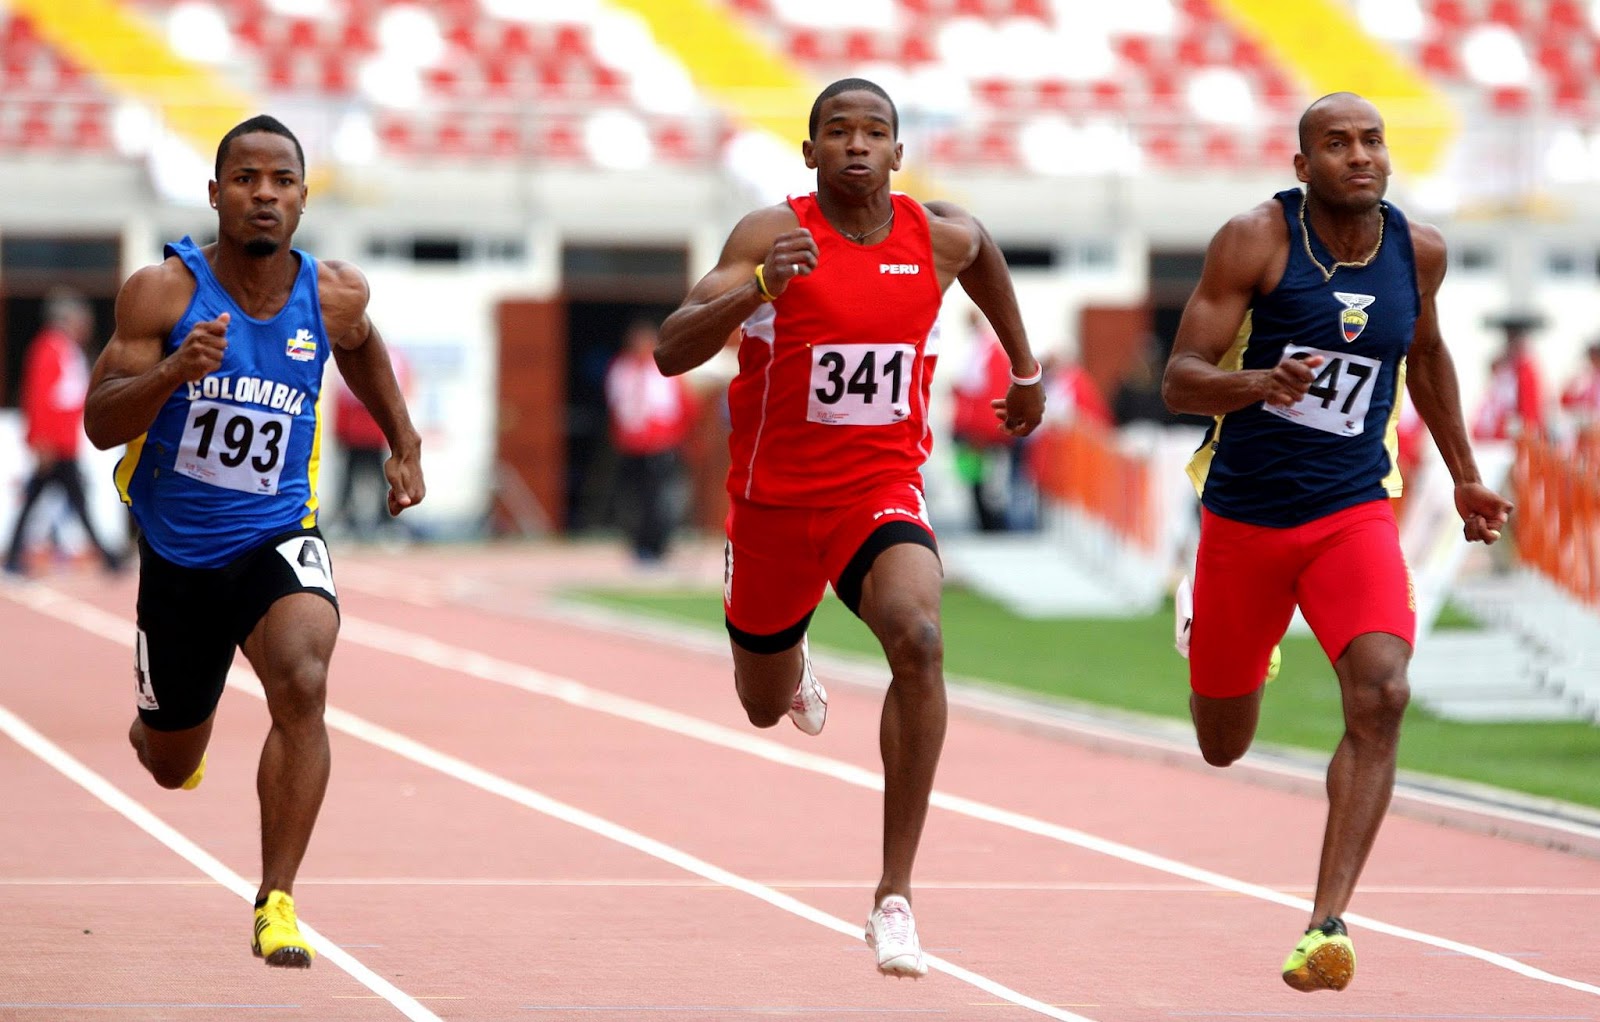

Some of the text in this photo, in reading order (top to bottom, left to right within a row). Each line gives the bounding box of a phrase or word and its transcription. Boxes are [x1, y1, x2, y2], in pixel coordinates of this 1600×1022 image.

[879, 264, 919, 274] PERU
[186, 376, 306, 415] COLOMBIA
[816, 351, 904, 404] 341
[1290, 352, 1374, 414] 47
[193, 408, 283, 473] 193
[297, 540, 328, 579] 4
